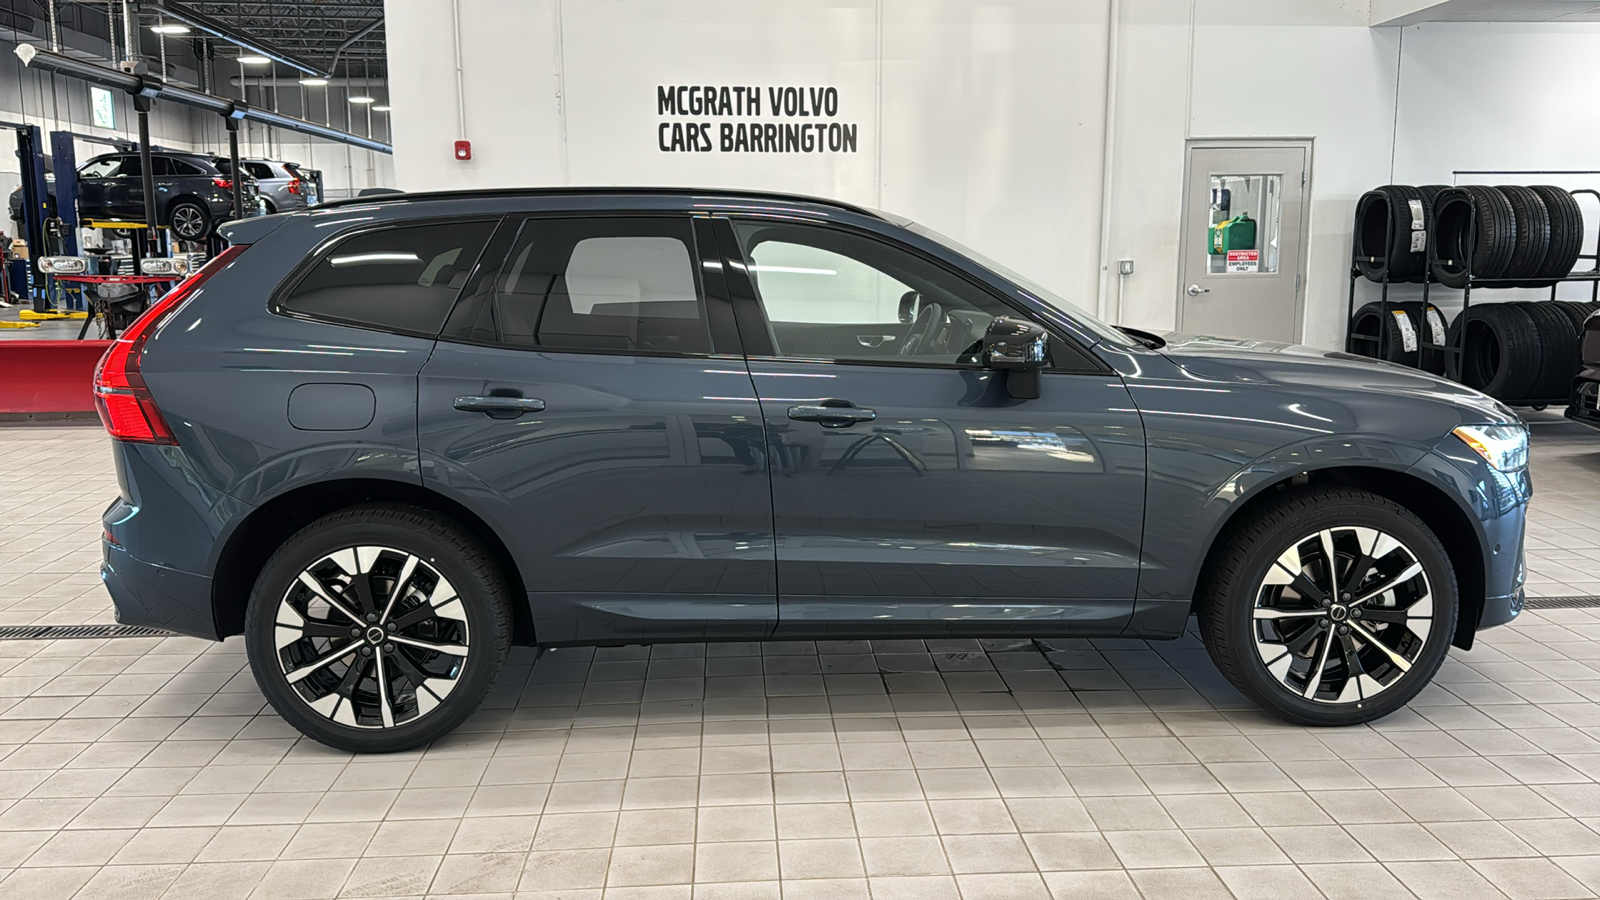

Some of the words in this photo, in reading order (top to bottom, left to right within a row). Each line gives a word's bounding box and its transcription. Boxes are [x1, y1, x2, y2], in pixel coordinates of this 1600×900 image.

[657, 86, 761, 116] MCGRATH
[768, 86, 838, 117] VOLVO
[658, 122, 713, 152] CARS
[720, 122, 858, 153] BARRINGTON
